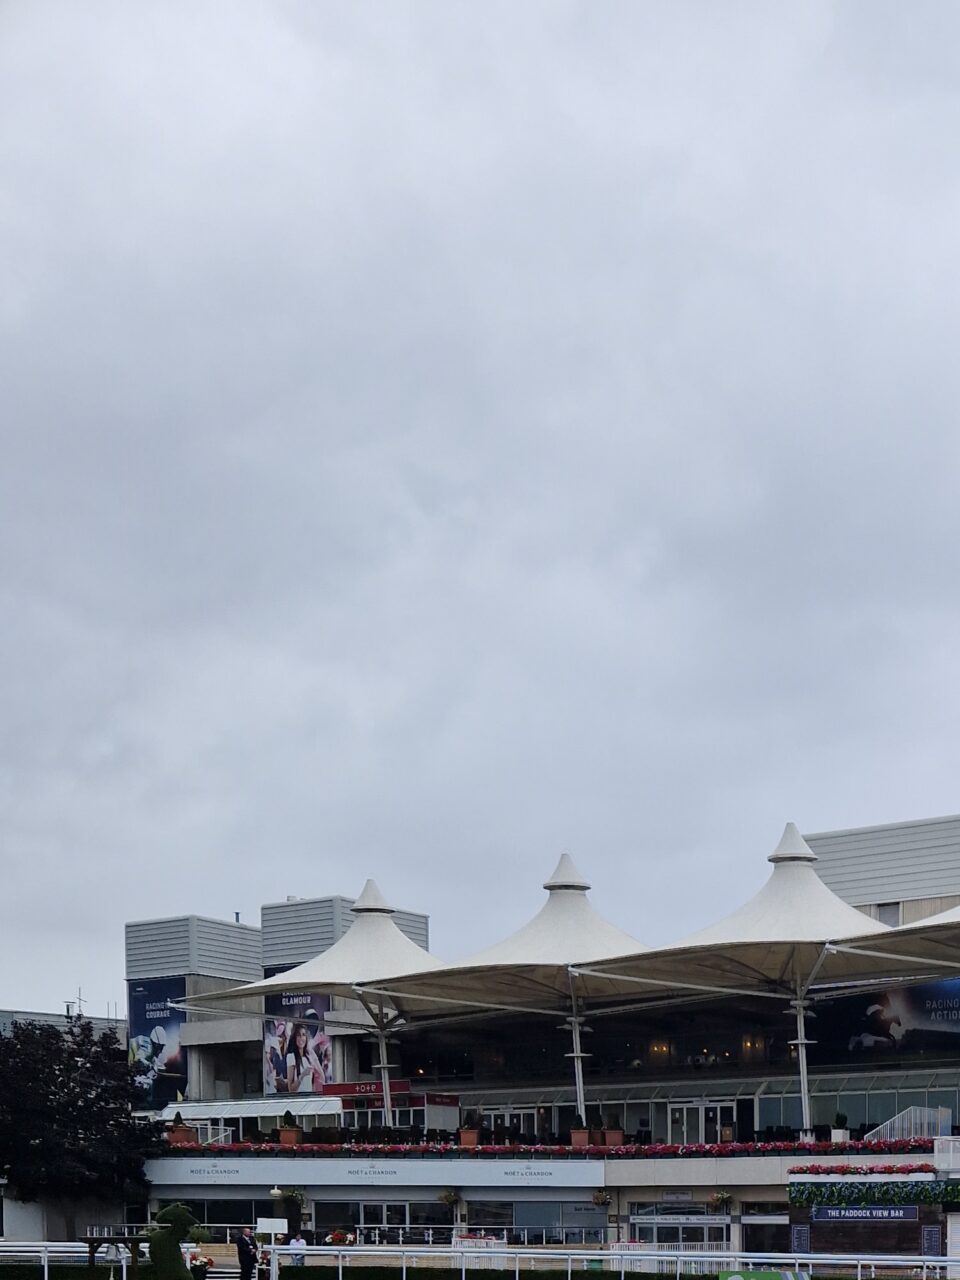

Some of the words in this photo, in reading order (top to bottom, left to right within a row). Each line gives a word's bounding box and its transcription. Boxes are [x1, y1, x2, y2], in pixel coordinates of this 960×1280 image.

[281, 996, 311, 1006] GLAMOUR
[925, 998, 960, 1009] RACING
[145, 1009, 171, 1019] COURAGE
[828, 1209, 840, 1217] THE
[841, 1209, 871, 1217] PADDOCK
[872, 1209, 889, 1217] VIEW
[890, 1209, 904, 1217] BAR
